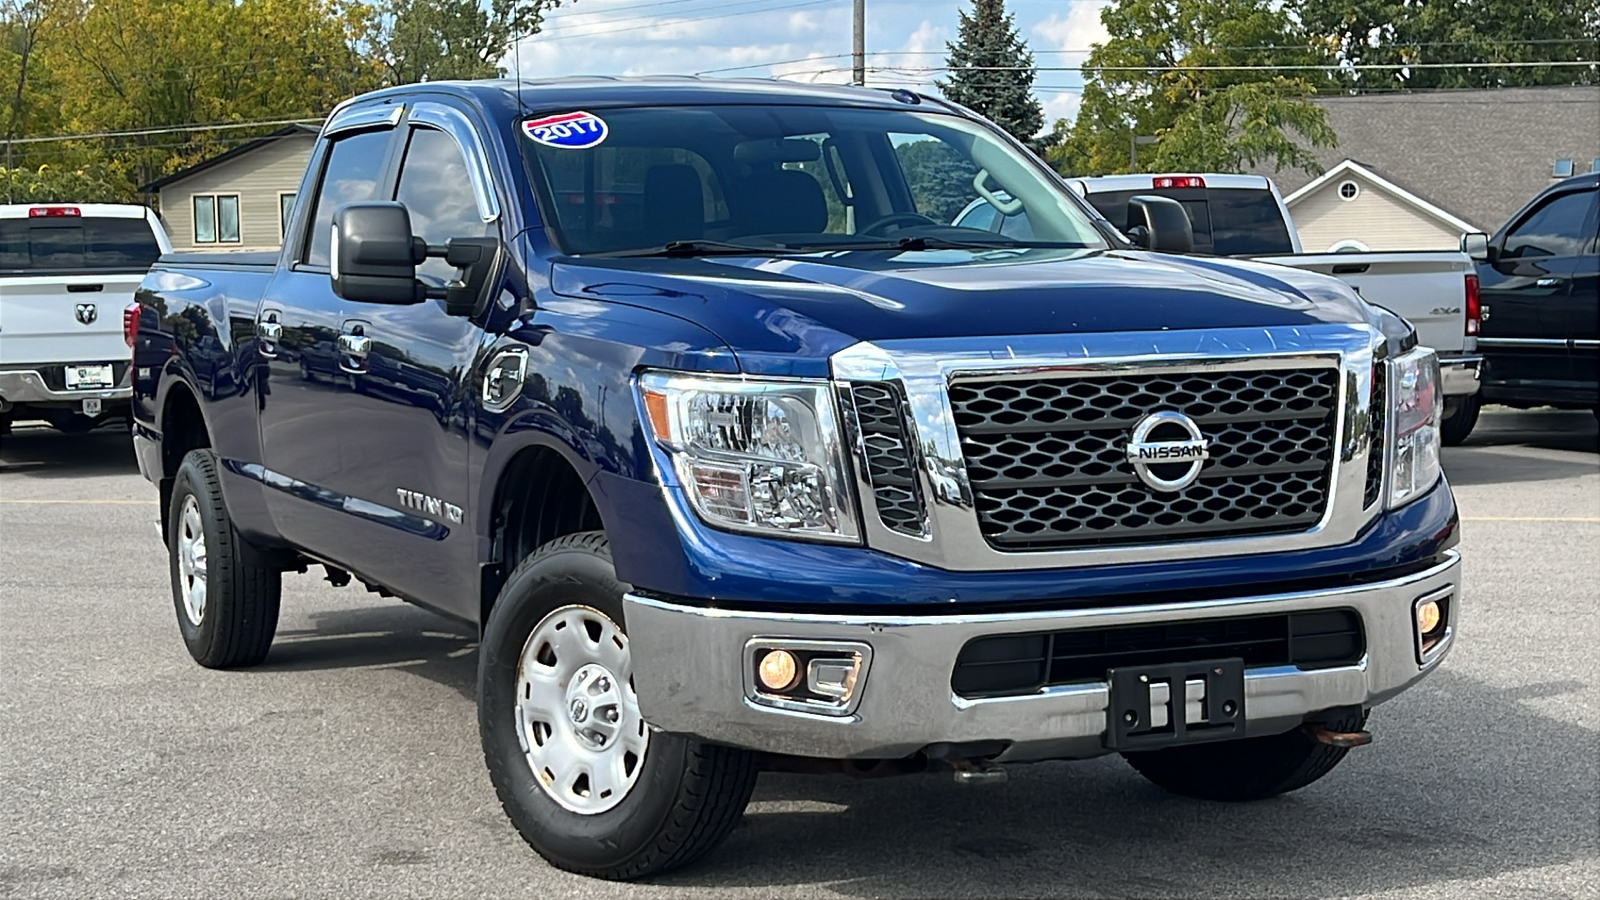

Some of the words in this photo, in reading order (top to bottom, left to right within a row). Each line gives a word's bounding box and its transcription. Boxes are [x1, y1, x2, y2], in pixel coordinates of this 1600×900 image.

[534, 119, 598, 141] 2017
[1139, 445, 1203, 459] NISSAN
[396, 488, 443, 516] TITAN
